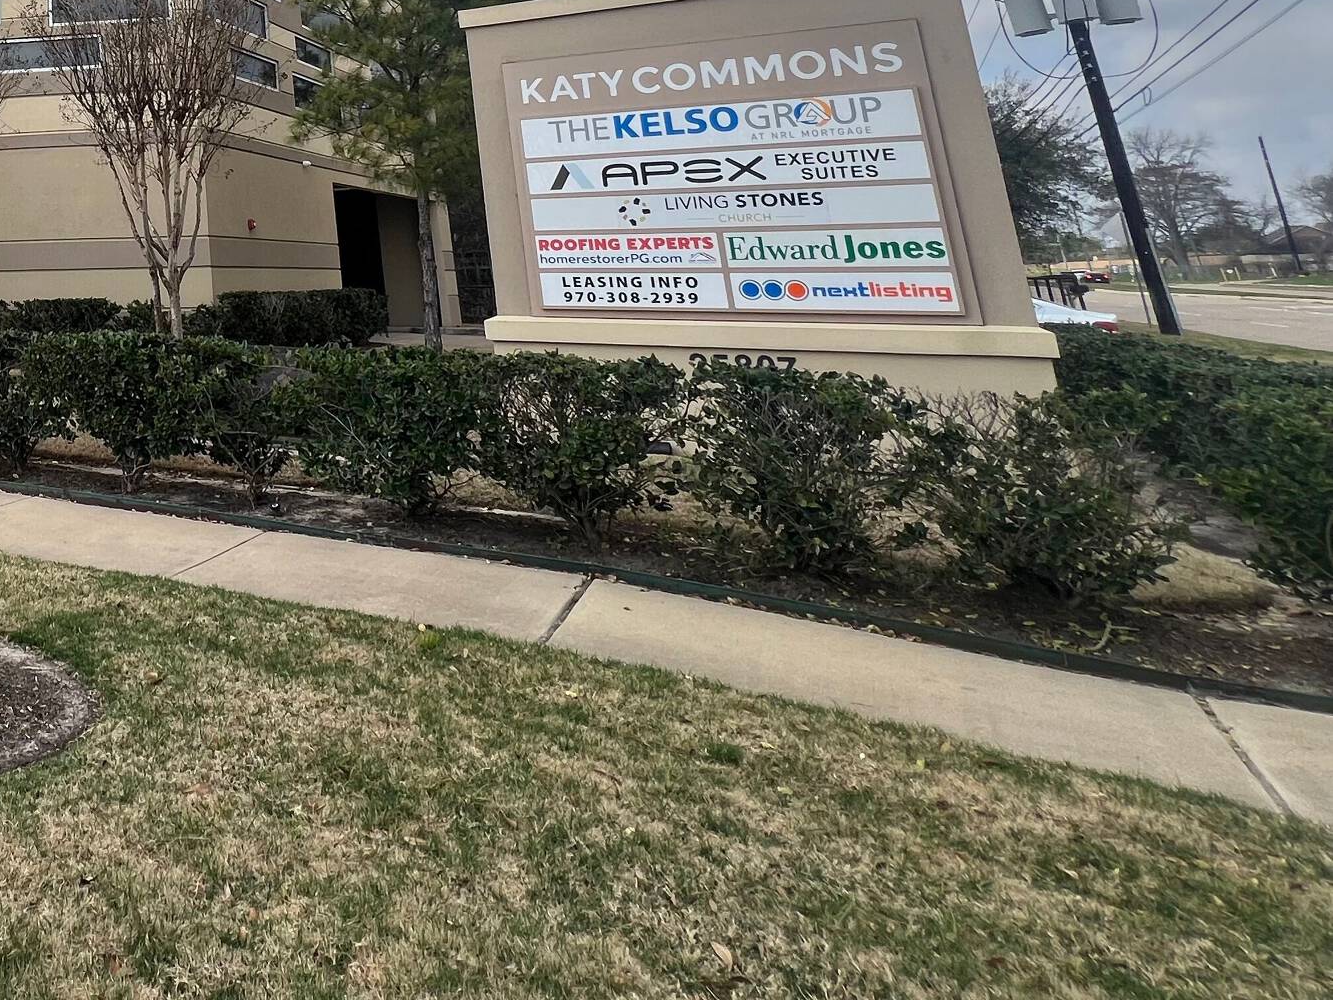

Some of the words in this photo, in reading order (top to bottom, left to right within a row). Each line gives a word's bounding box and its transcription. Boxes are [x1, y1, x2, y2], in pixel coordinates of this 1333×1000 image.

[520, 70, 624, 105] KATY
[631, 42, 903, 94] COMMONS
[547, 117, 611, 144] THE
[612, 107, 739, 139] KELSO
[744, 96, 882, 130] GROUP
[751, 133, 765, 141] AT
[771, 131, 795, 140] NRL
[801, 126, 873, 137] MORTGAGE
[774, 148, 897, 166] EXECUTIVE
[601, 156, 767, 188] APEX
[801, 165, 879, 181] SUITES
[664, 194, 729, 211] LIVING
[735, 191, 824, 208] STONES
[718, 213, 772, 222] CHURCH
[538, 238, 621, 251] ROOFING
[626, 236, 714, 250] EXPERTS
[727, 234, 841, 261] Edward
[844, 235, 946, 263] Jones
[540, 253, 683, 265] homerestorerPG.com
[562, 276, 643, 288] LEASING
[650, 276, 698, 288] INFO
[563, 292, 699, 304] 970-308-2939
